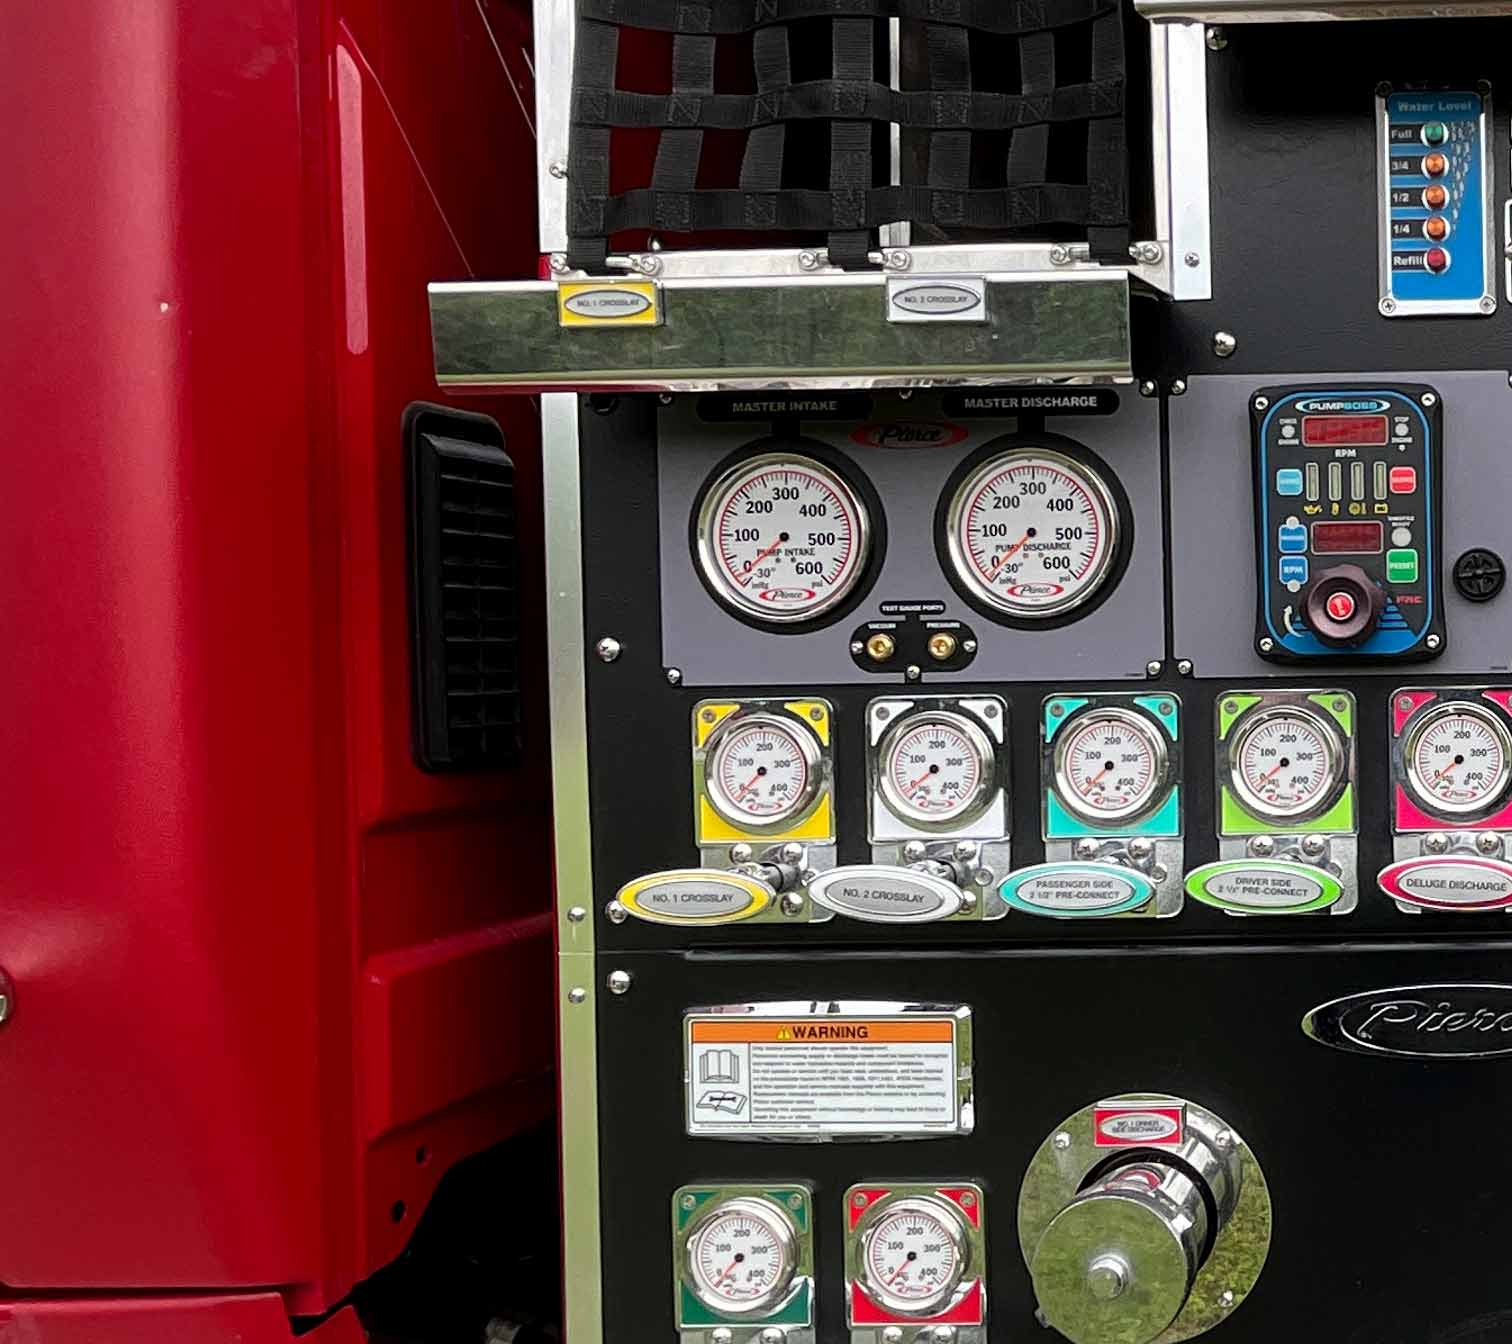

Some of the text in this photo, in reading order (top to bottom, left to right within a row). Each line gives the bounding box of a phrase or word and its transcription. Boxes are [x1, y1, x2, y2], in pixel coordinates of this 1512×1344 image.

[1398, 102, 1472, 112] Water Level
[1392, 129, 1412, 139] Full
[1392, 161, 1409, 170] 3/4
[1393, 193, 1409, 203] 1/2
[1393, 224, 1410, 234] 1/4
[1393, 255, 1423, 266] Refill
[732, 401, 838, 413] MASTER INTAKE
[965, 396, 1097, 408] MASTER DISCHARGE
[1309, 402, 1378, 411] PUMPBOSS
[1019, 482, 1046, 495] 300
[772, 488, 799, 500] 300
[746, 501, 773, 513] 200
[993, 496, 1020, 509] 200
[1046, 499, 1074, 511] 400
[799, 504, 826, 517] 400
[735, 529, 760, 541] 100
[982, 524, 1007, 537] 100
[1055, 528, 1082, 540] 500
[808, 533, 835, 546] 500
[1023, 542, 1071, 551] DISCHARGE
[785, 548, 815, 556] INTAKE
[744, 561, 752, 572] 0
[991, 555, 999, 568] 0
[1043, 557, 1070, 570] 600
[795, 562, 823, 574] 600
[1283, 566, 1303, 574] RPM
[1280, 735, 1297, 743] 200
[1453, 731, 1471, 739] 200
[928, 741, 946, 749] 200
[1104, 737, 1121, 745] 200
[756, 744, 773, 752] 200
[1260, 748, 1277, 756] 100
[1434, 745, 1450, 753] 100
[910, 755, 926, 763] 100
[1084, 752, 1101, 760] 100
[1036, 880, 1113, 888] PASSENGER SIDE
[1235, 877, 1291, 886] DRIVER SIDE
[1406, 878, 1507, 891] DELUGE DISCHARGE
[843, 889, 925, 903] NO. 2 CROSSLAY
[1055, 891, 1120, 899] PRE-CONNECT
[1242, 886, 1308, 896] PRE-CONNECT
[653, 894, 670, 902] NO.
[681, 894, 733, 903] CROSSLAY
[793, 1026, 869, 1039] WARNING
[733, 1229, 750, 1238] 200
[906, 1227, 924, 1236] 200
[715, 1244, 731, 1253] 100
[888, 1242, 904, 1250] 100
